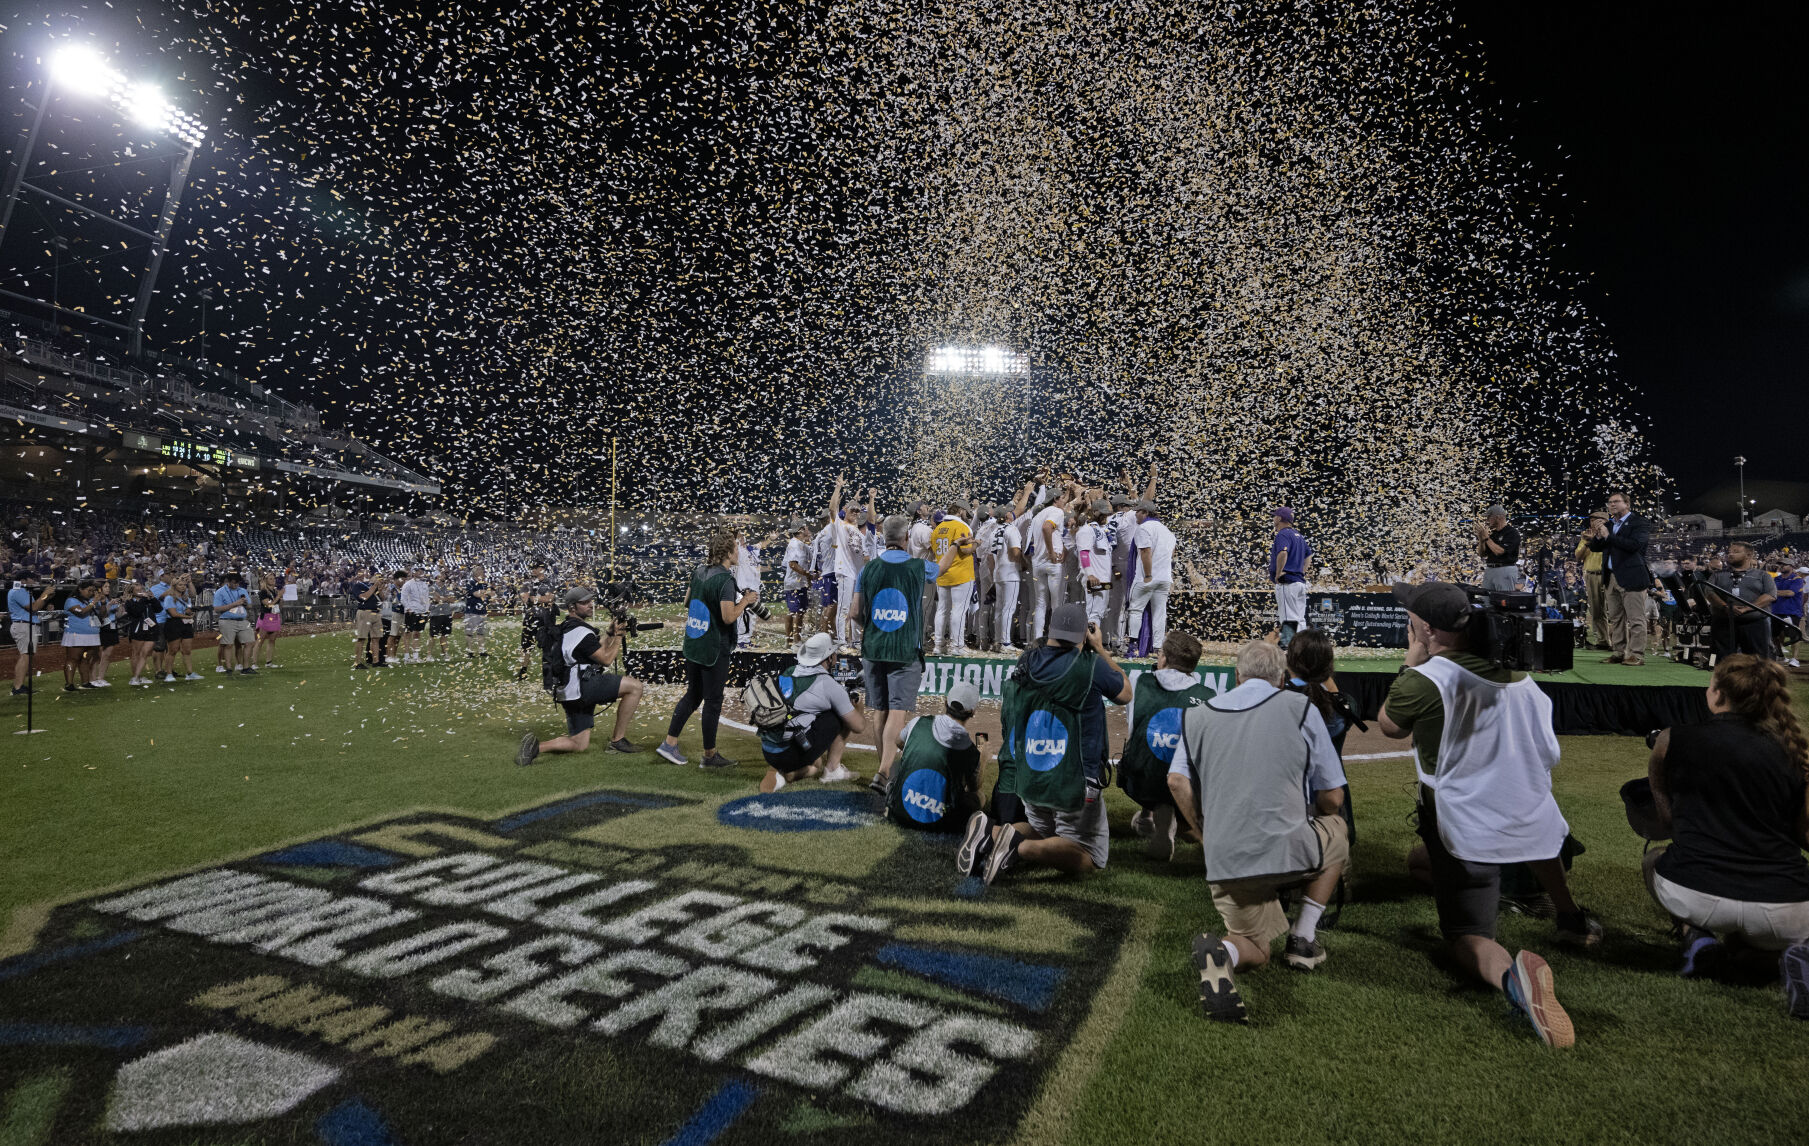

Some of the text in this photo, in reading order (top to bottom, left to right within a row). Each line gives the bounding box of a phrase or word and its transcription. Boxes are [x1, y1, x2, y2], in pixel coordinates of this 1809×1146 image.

[935, 537, 950, 556] 38
[687, 616, 709, 631] NCAA
[874, 608, 906, 623] NCAA
[1026, 737, 1066, 755] NCAA
[1152, 732, 1180, 749] NC
[905, 789, 945, 817] NCAA
[357, 852, 892, 974] COLLEGE
[90, 868, 1041, 1116] WORLD SERIES
